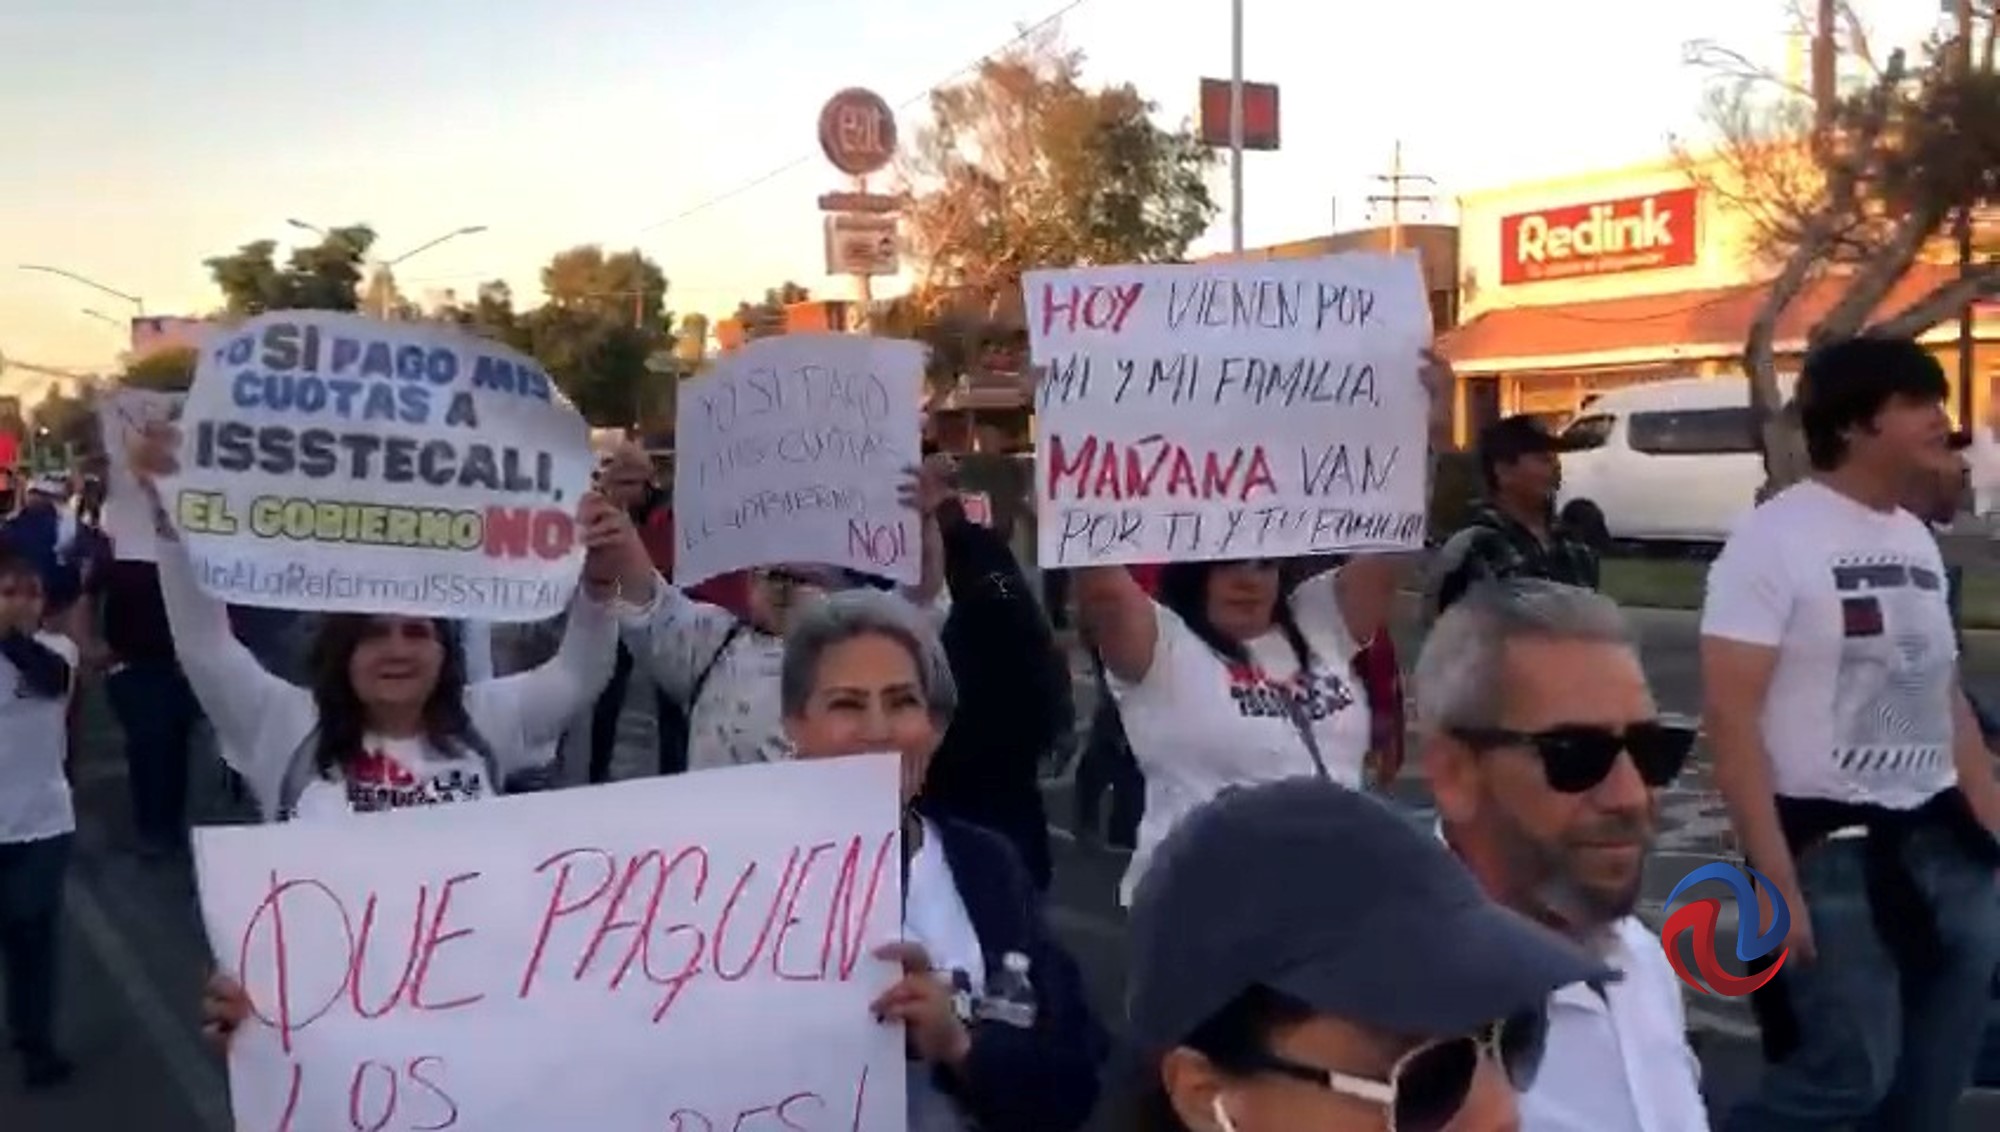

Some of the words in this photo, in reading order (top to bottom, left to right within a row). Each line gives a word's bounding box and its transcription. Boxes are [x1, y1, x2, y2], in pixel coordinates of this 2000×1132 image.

[1518, 198, 1673, 263] Redink
[1043, 281, 1144, 336] HOY
[1166, 281, 1301, 332] VIENEN
[1317, 282, 1384, 330] POR
[262, 322, 320, 373] SI
[331, 337, 457, 385] PAGO
[471, 355, 549, 402] MIS
[747, 363, 783, 416] SI
[1044, 352, 1091, 408] MI
[1115, 358, 1134, 403] Y
[1147, 354, 1200, 405] MI
[232, 369, 432, 424] CUOTAS
[445, 391, 478, 429] A
[195, 420, 563, 500] ISSSTECALI,
[1049, 433, 1278, 502] MAÑANA
[1301, 444, 1400, 497] VAN
[178, 489, 237, 535] EL
[250, 497, 484, 551] GOBIERNO
[483, 504, 575, 561] NO
[1058, 509, 1143, 563] POR
[1166, 511, 1201, 550] TI
[1219, 509, 1248, 552] Y
[518, 830, 897, 1025] PAGUEN
